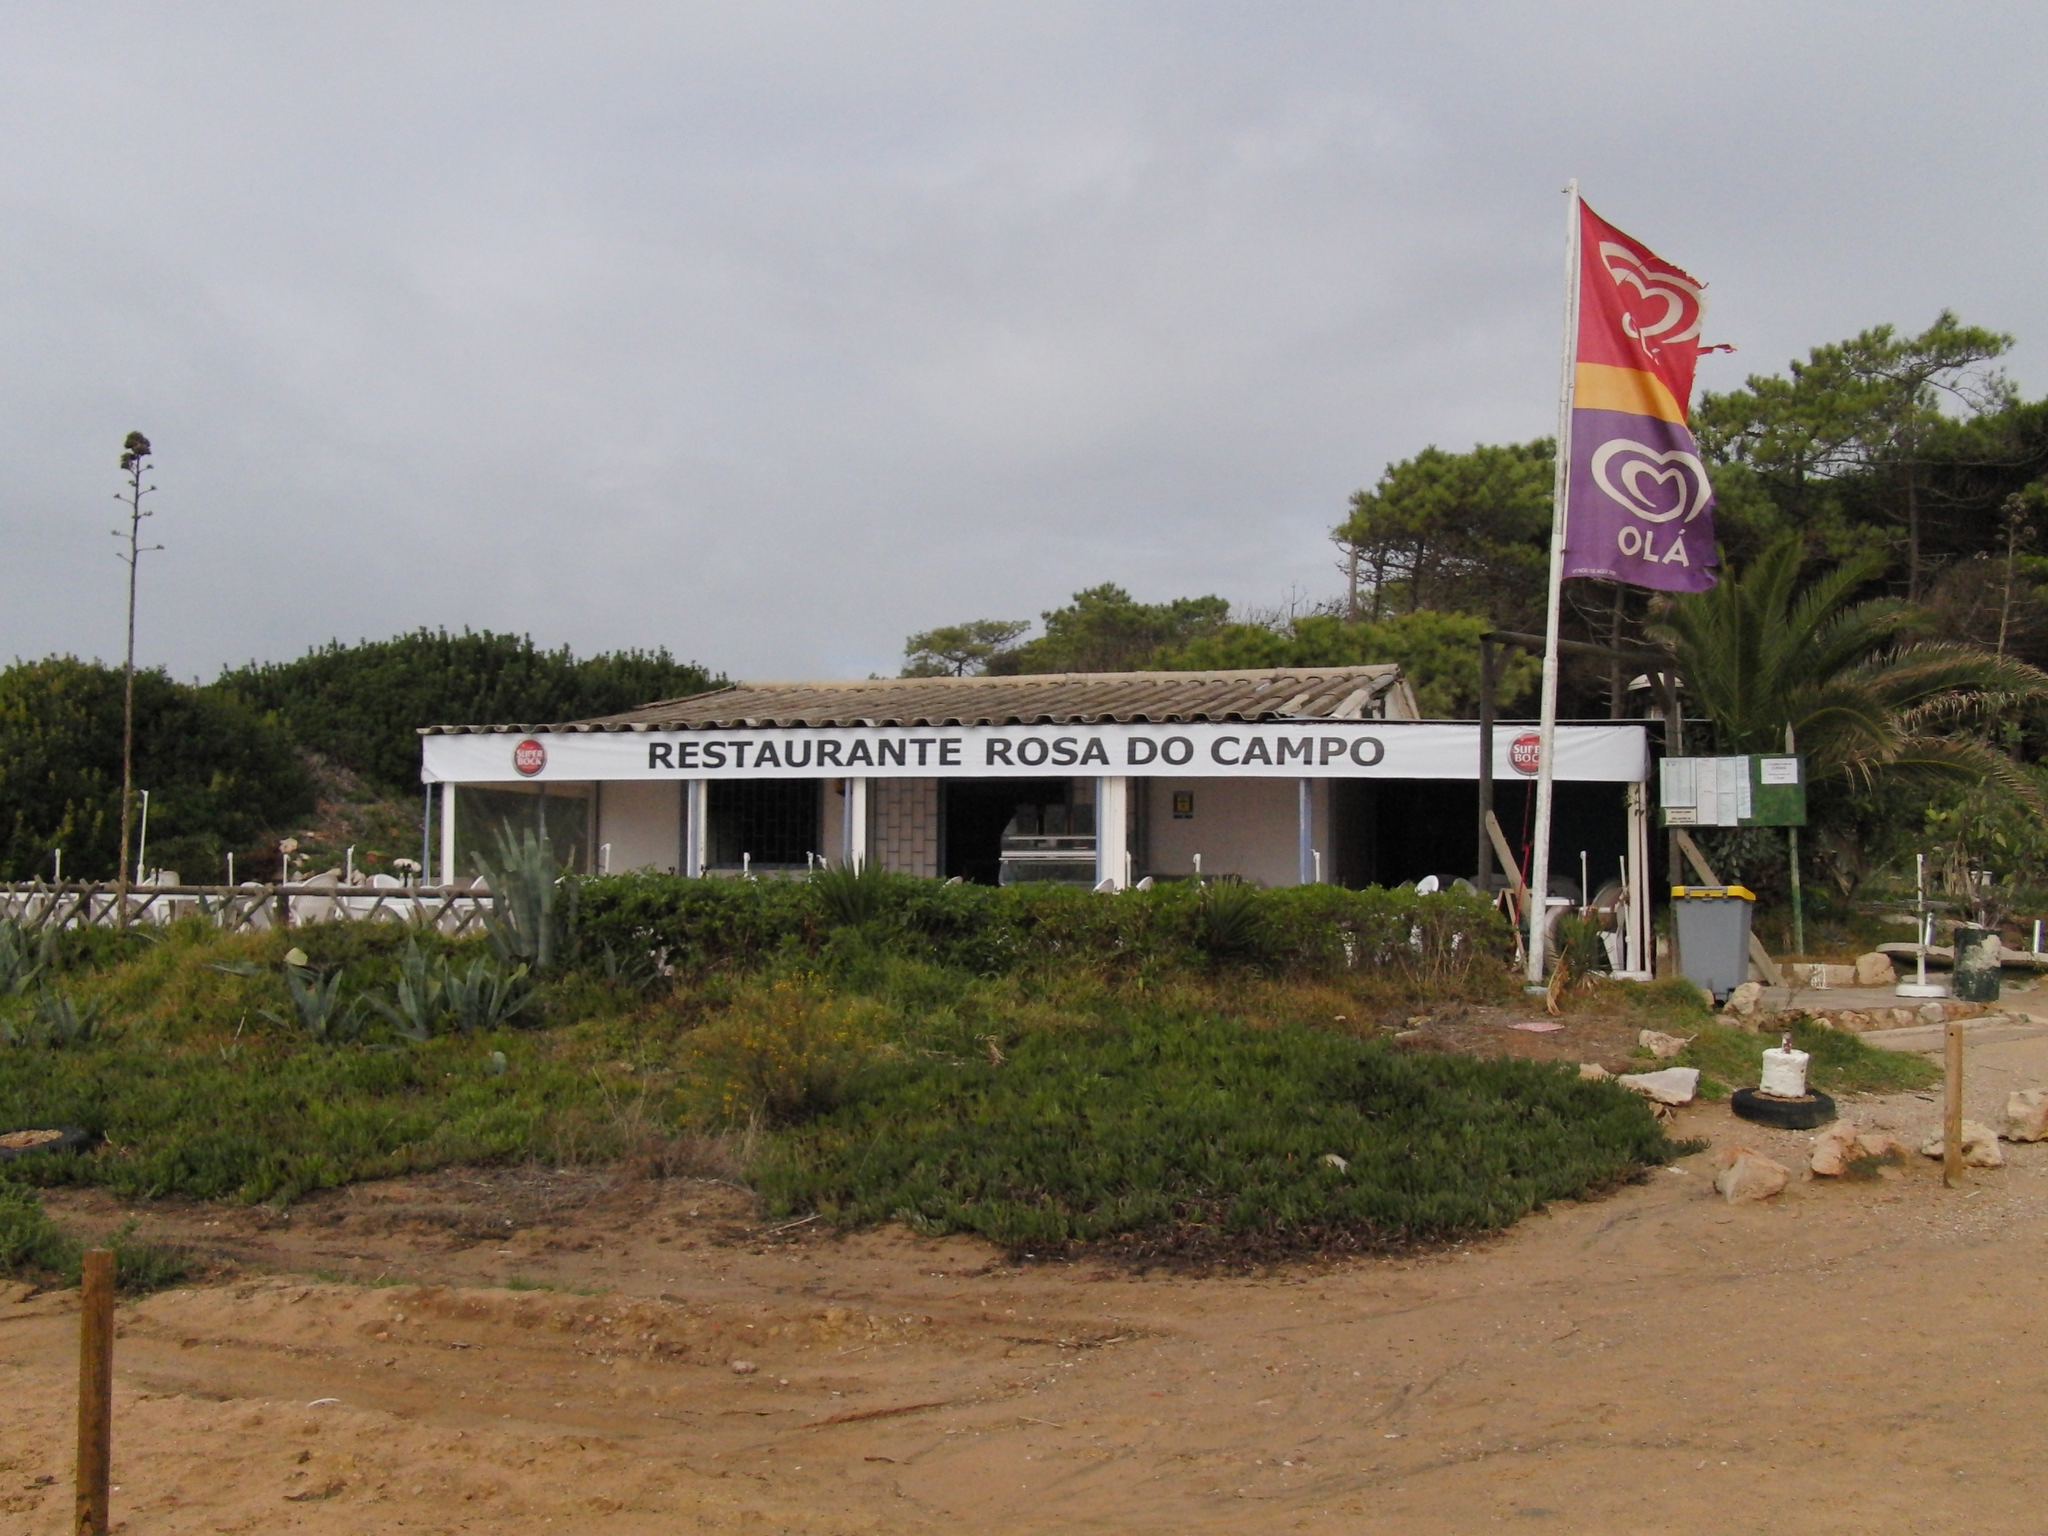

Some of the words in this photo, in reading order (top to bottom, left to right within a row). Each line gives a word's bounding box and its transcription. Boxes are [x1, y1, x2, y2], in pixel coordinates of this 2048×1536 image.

[1618, 525, 1690, 567] OLÁ
[516, 748, 544, 758] SUPER
[648, 738, 962, 769] RESTAURANTE
[985, 737, 1110, 766] ROSA
[1127, 736, 1195, 766] DO
[1211, 736, 1385, 767] CAMPO
[1513, 744, 1541, 754] SUPE
[517, 757, 543, 766] BOCK
[1514, 753, 1540, 763] BOC
